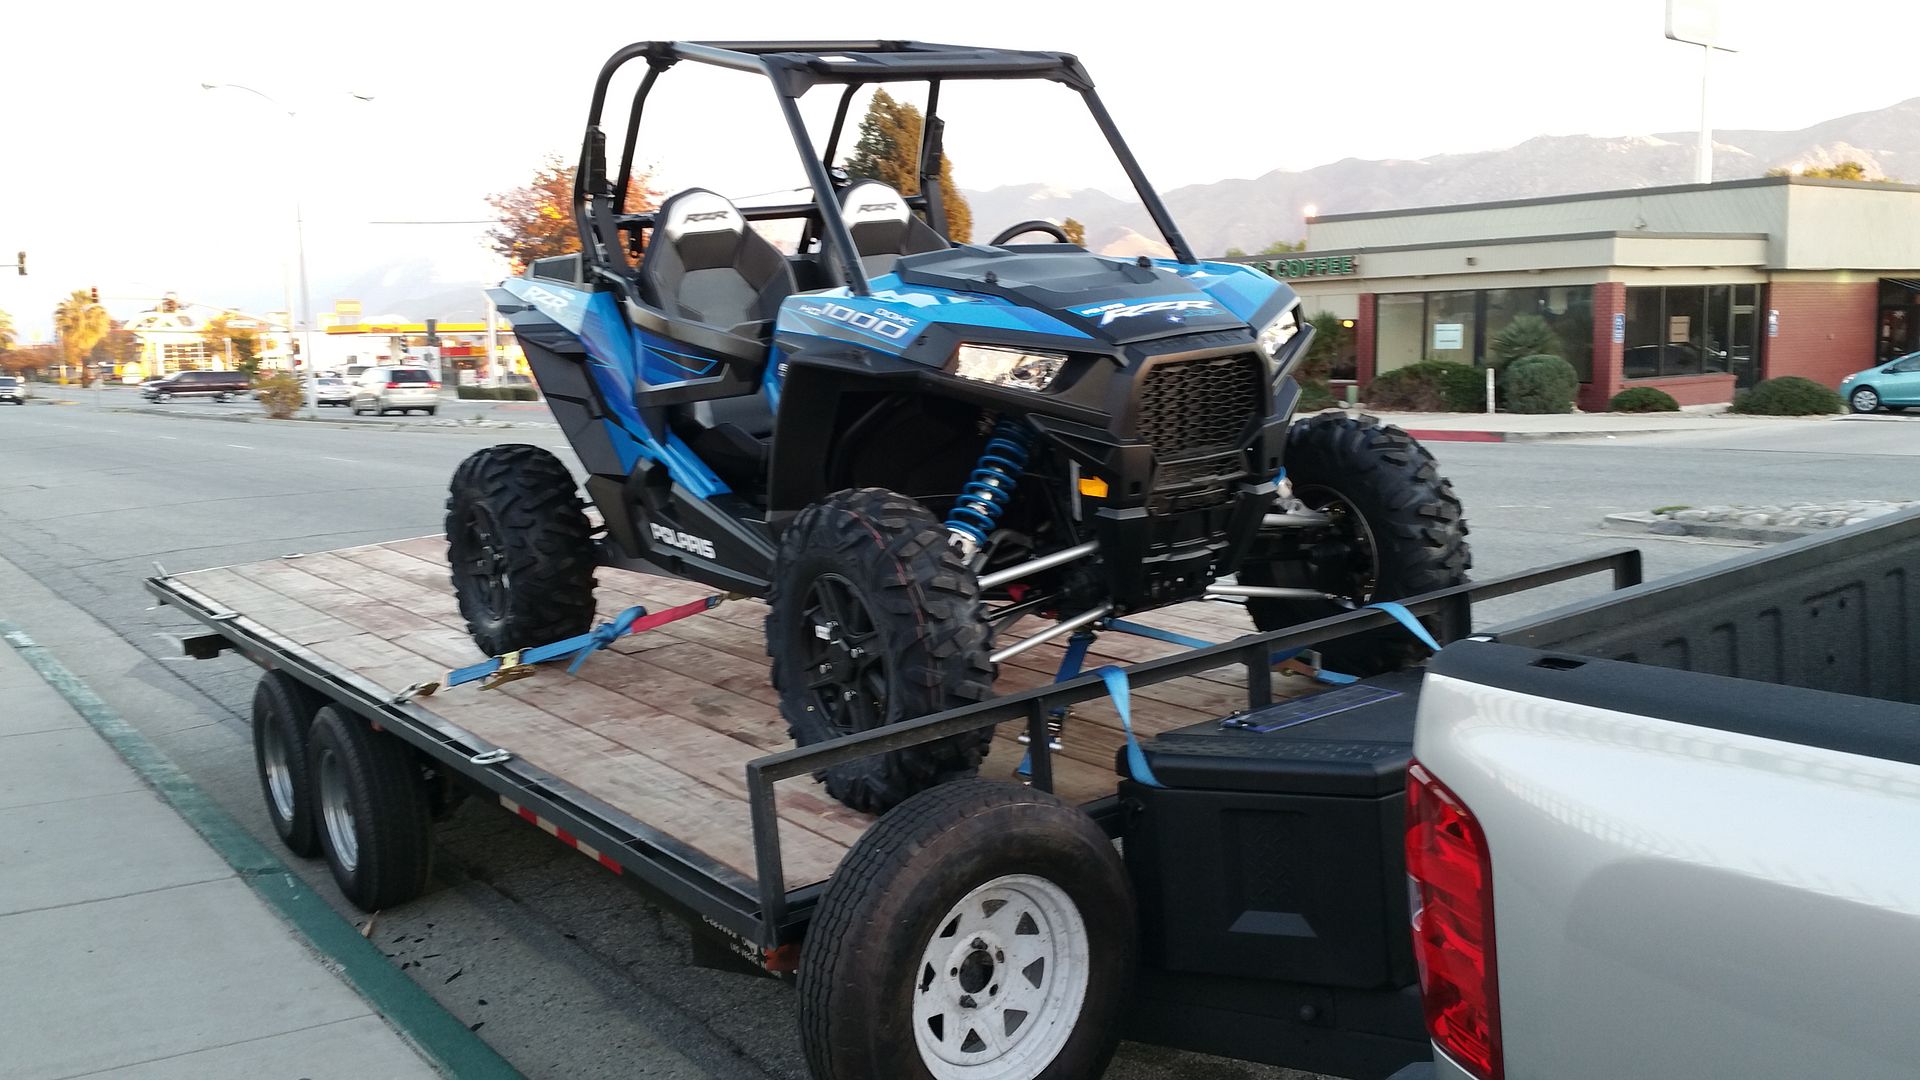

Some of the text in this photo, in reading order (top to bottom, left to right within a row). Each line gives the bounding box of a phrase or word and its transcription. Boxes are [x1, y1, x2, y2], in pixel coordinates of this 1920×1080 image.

[684, 210, 729, 224] RZR
[1277, 255, 1355, 278] COFFEE
[821, 302, 909, 339] 1000
[1099, 300, 1214, 328] RZR
[649, 522, 717, 559] POLARIS
